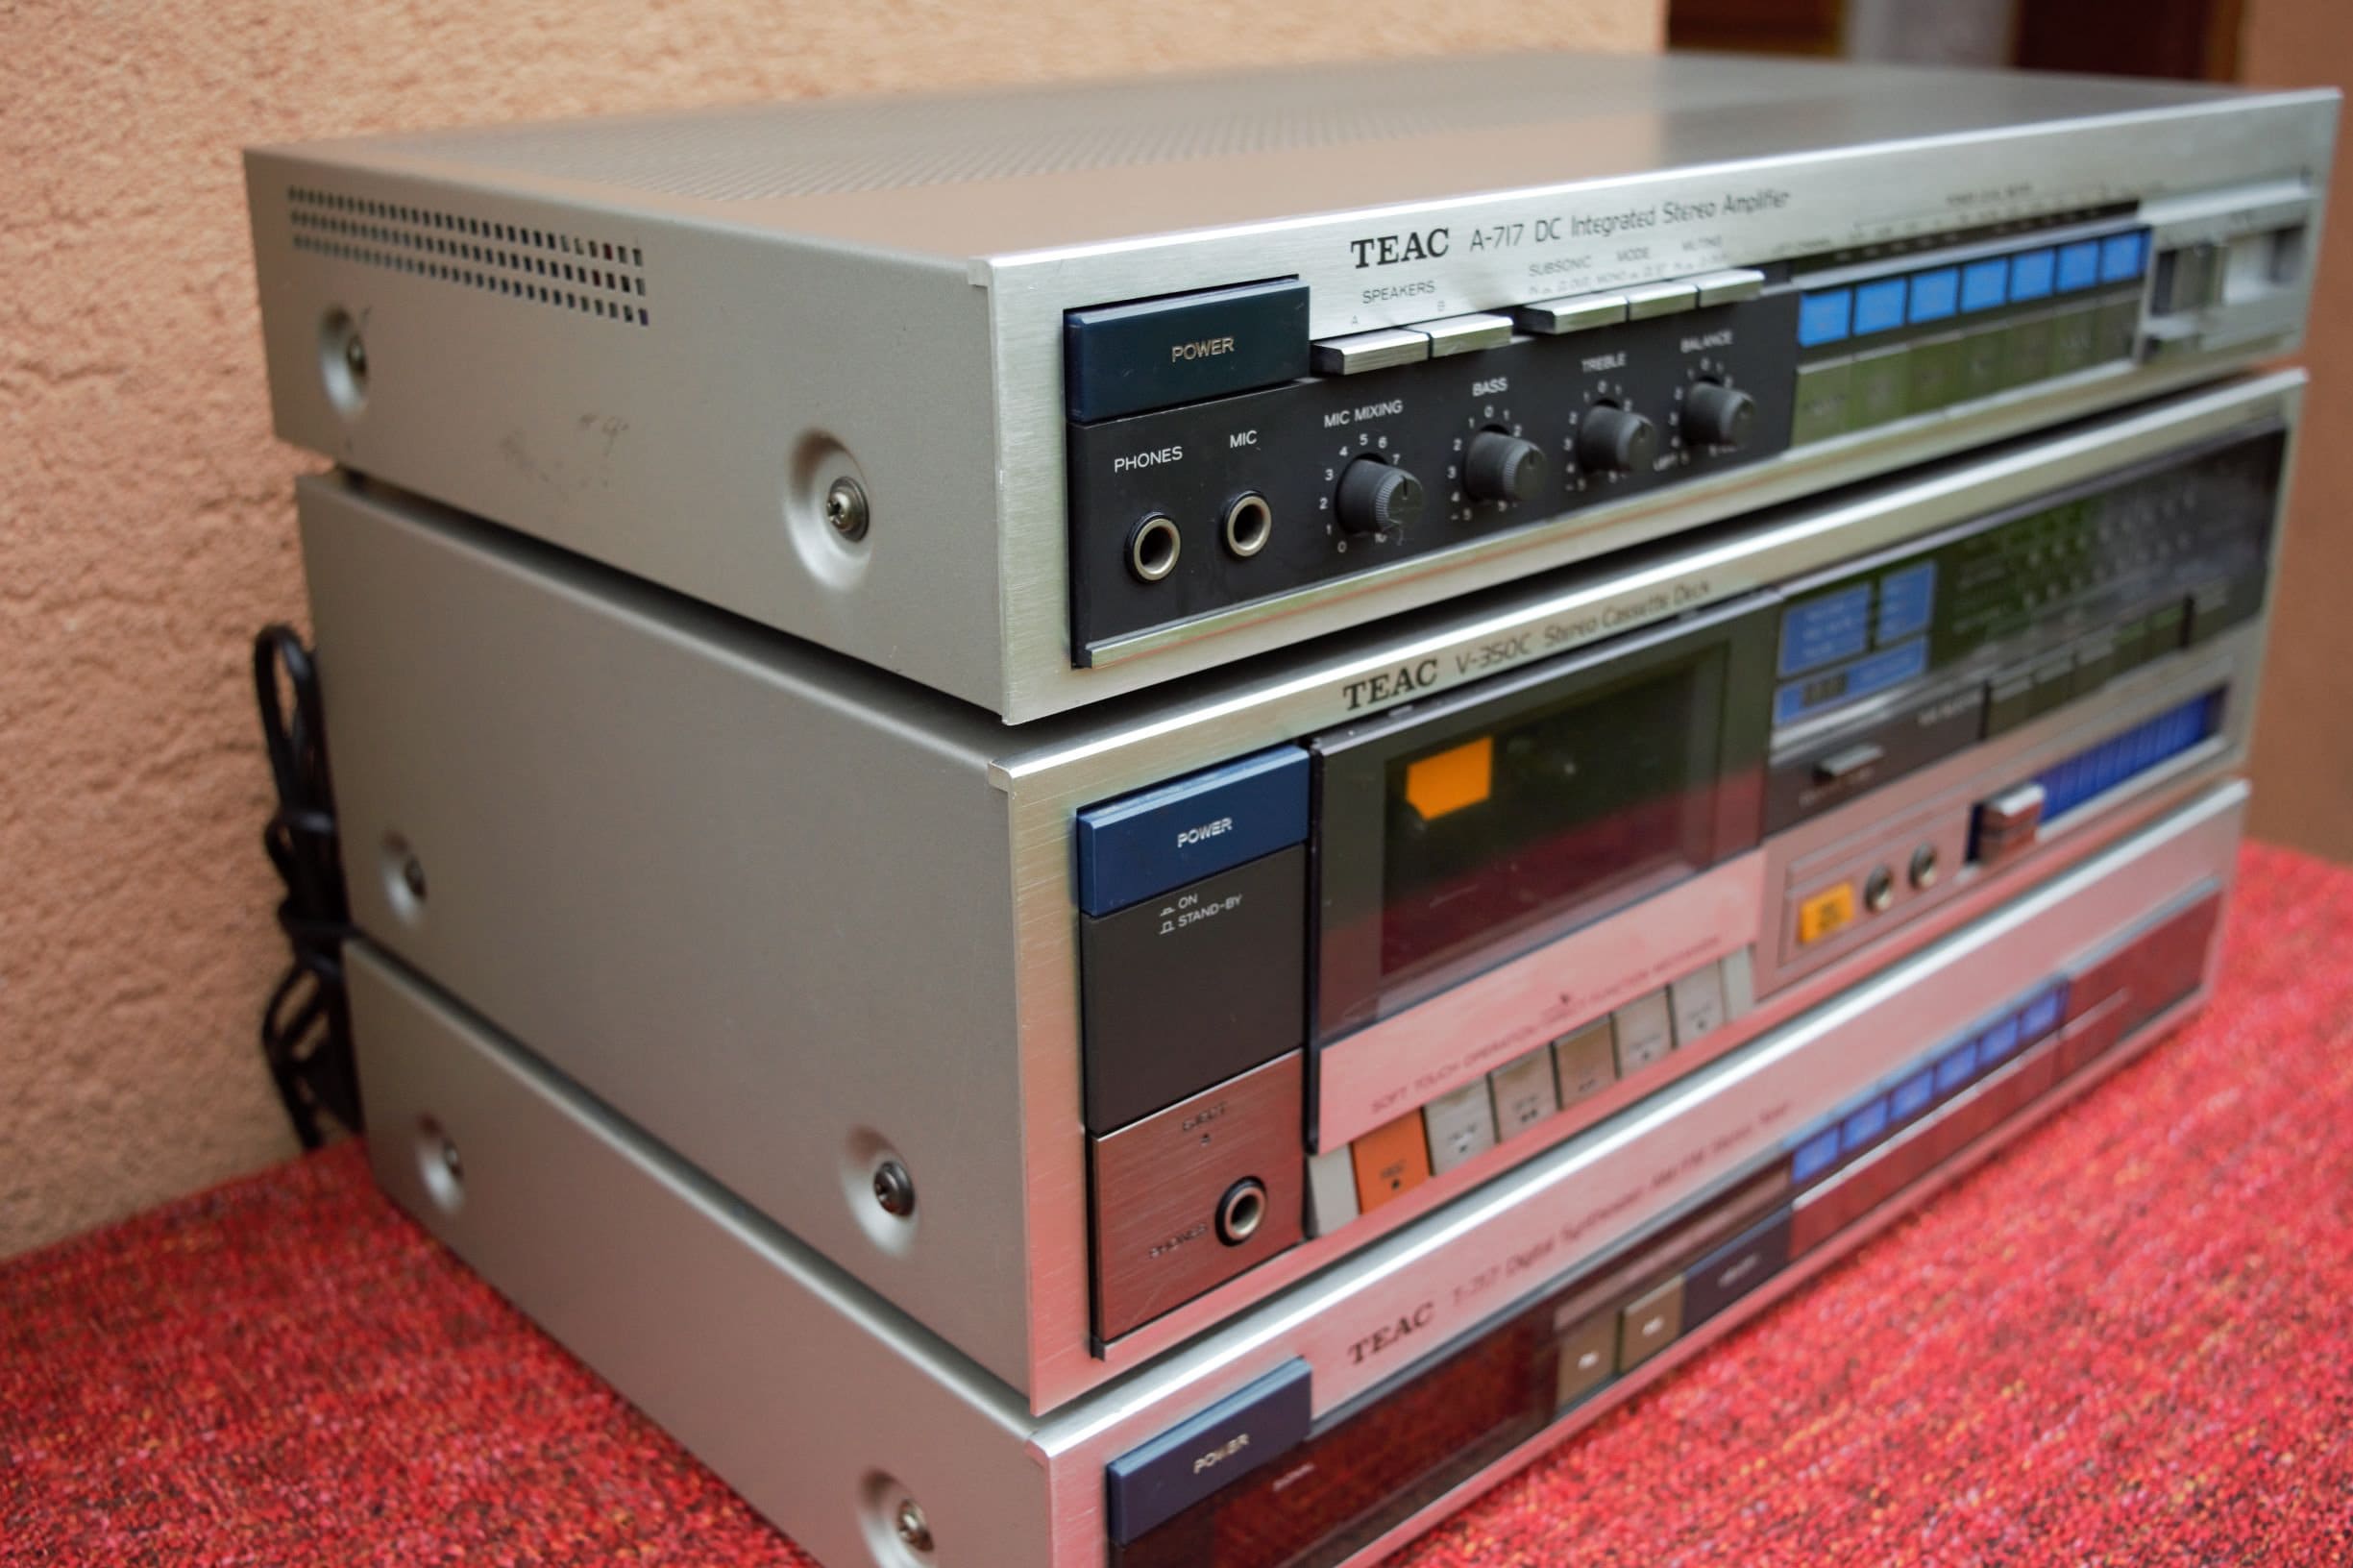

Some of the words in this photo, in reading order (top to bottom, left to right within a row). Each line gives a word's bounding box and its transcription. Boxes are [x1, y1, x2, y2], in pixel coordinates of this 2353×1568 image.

[1351, 229, 1450, 270] TEAC
[1470, 224, 1525, 253] A-717
[1534, 217, 1561, 243] DC
[1571, 206, 1656, 238] Integrated
[1662, 200, 1716, 225] Stereo
[1722, 190, 1790, 214] Amplifier
[1362, 281, 1435, 306] SPEAKERS
[1351, 315, 1360, 327] A
[1171, 336, 1235, 363] POWER
[1680, 331, 1733, 354] BALANCE
[1581, 351, 1627, 372] TREBLE
[1472, 377, 1508, 397] BASS
[1324, 410, 1351, 429] MIC
[1354, 400, 1404, 422] MIXING
[1484, 404, 1494, 418] 0
[1229, 429, 1258, 449] MIC
[1360, 433, 1368, 446] 5
[1378, 437, 1387, 449] 6
[1453, 438, 1461, 452] 2
[1113, 446, 1184, 473] PHONES
[1338, 446, 1349, 457] 4
[1392, 453, 1401, 466] 7
[1325, 469, 1334, 481] 3
[1448, 466, 1457, 479] 3
[1319, 497, 1328, 510] 2
[1327, 524, 1333, 536] 1
[1336, 541, 1347, 553] 0
[1342, 658, 1438, 712] TEAC
[1455, 632, 1532, 676] V-350C
[1542, 617, 1599, 648] Stereo
[1601, 593, 1670, 628] Cassette
[1674, 578, 1710, 607] Deck
[1177, 817, 1233, 848] POWER
[1178, 894, 1198, 909] ON
[1178, 894, 1243, 928] STAND-BY
[1347, 1300, 1434, 1365] TEAC
[1193, 1433, 1249, 1475] POWER
